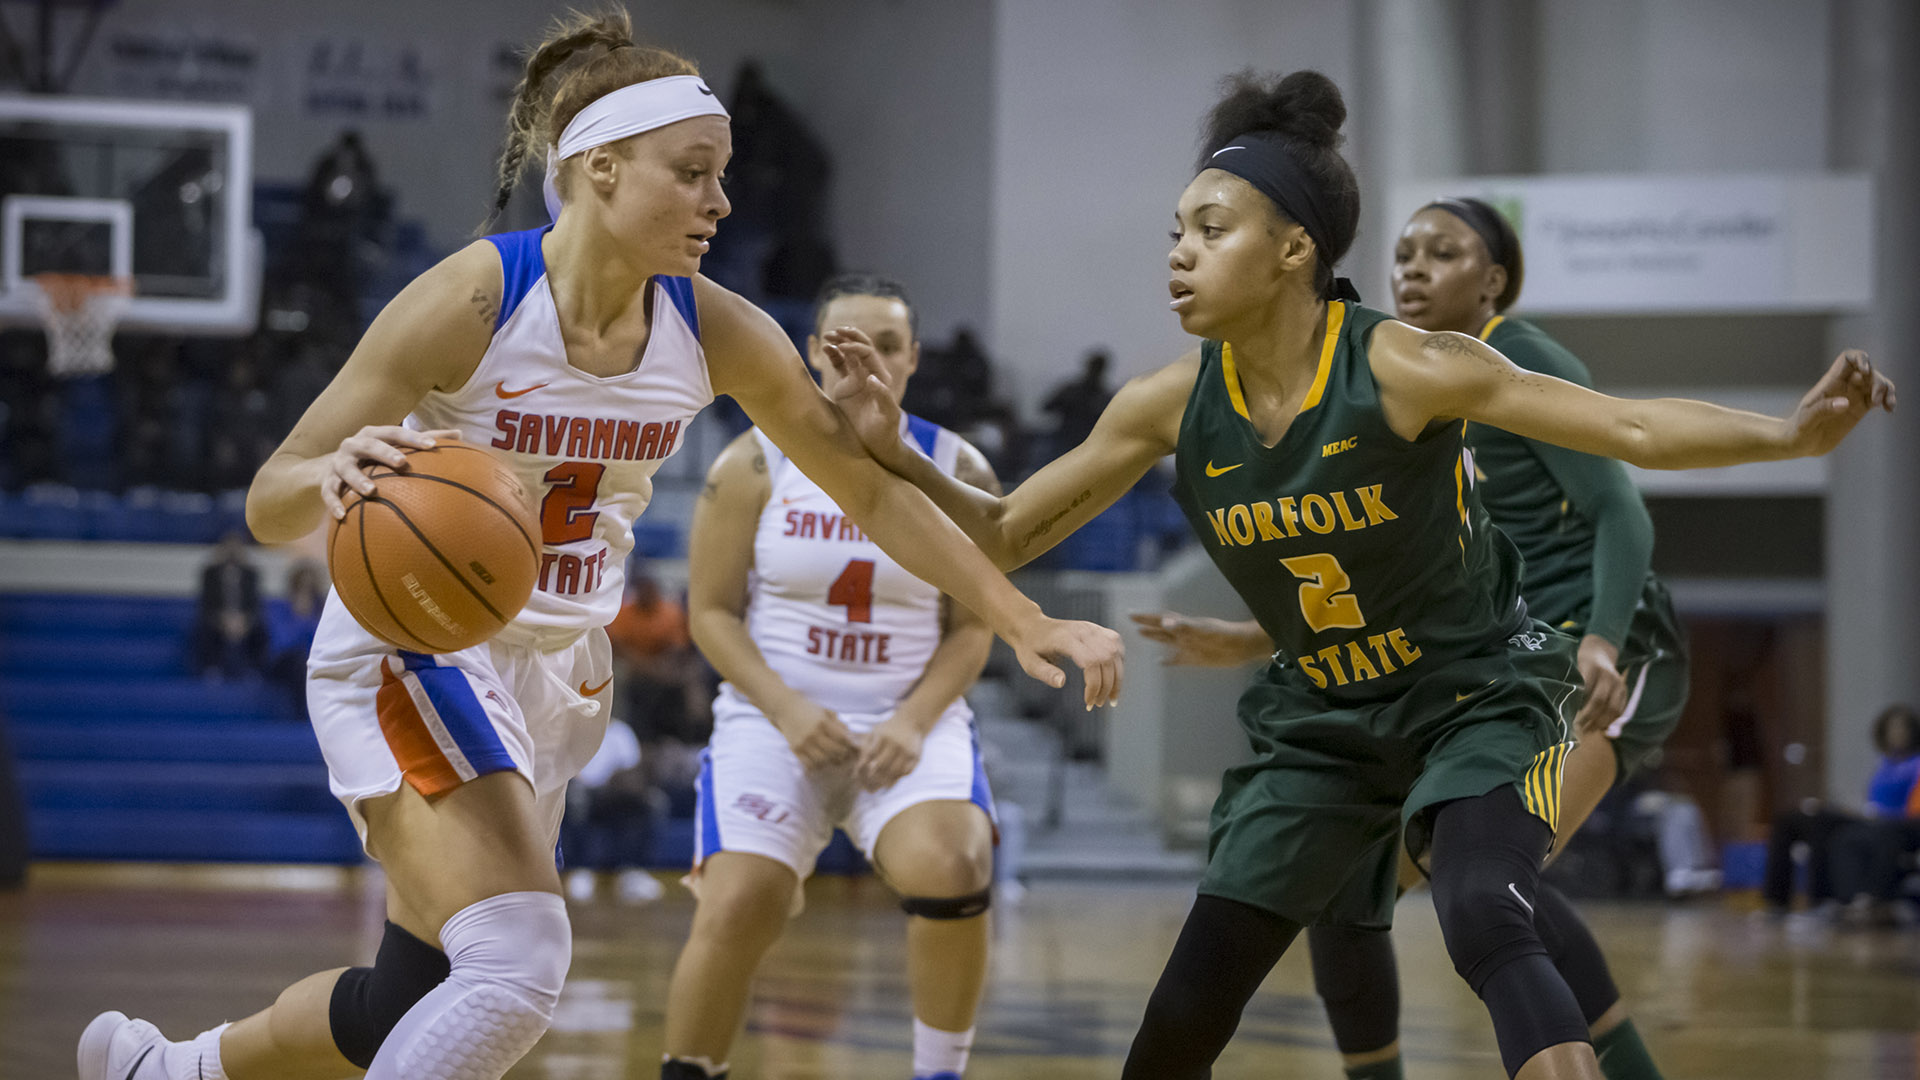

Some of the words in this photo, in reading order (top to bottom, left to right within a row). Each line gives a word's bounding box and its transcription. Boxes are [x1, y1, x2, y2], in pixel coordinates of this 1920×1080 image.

[491, 409, 681, 461] SAVANNAH
[1321, 435, 1358, 458] MEAC
[539, 461, 607, 546] 2
[783, 509, 869, 542] SAVA
[1206, 483, 1400, 547] NORFOLK
[538, 547, 608, 595] TATE
[826, 557, 876, 624] 4
[1279, 552, 1367, 634] 2
[806, 624, 892, 664] STATE
[1298, 627, 1423, 689] STATE
